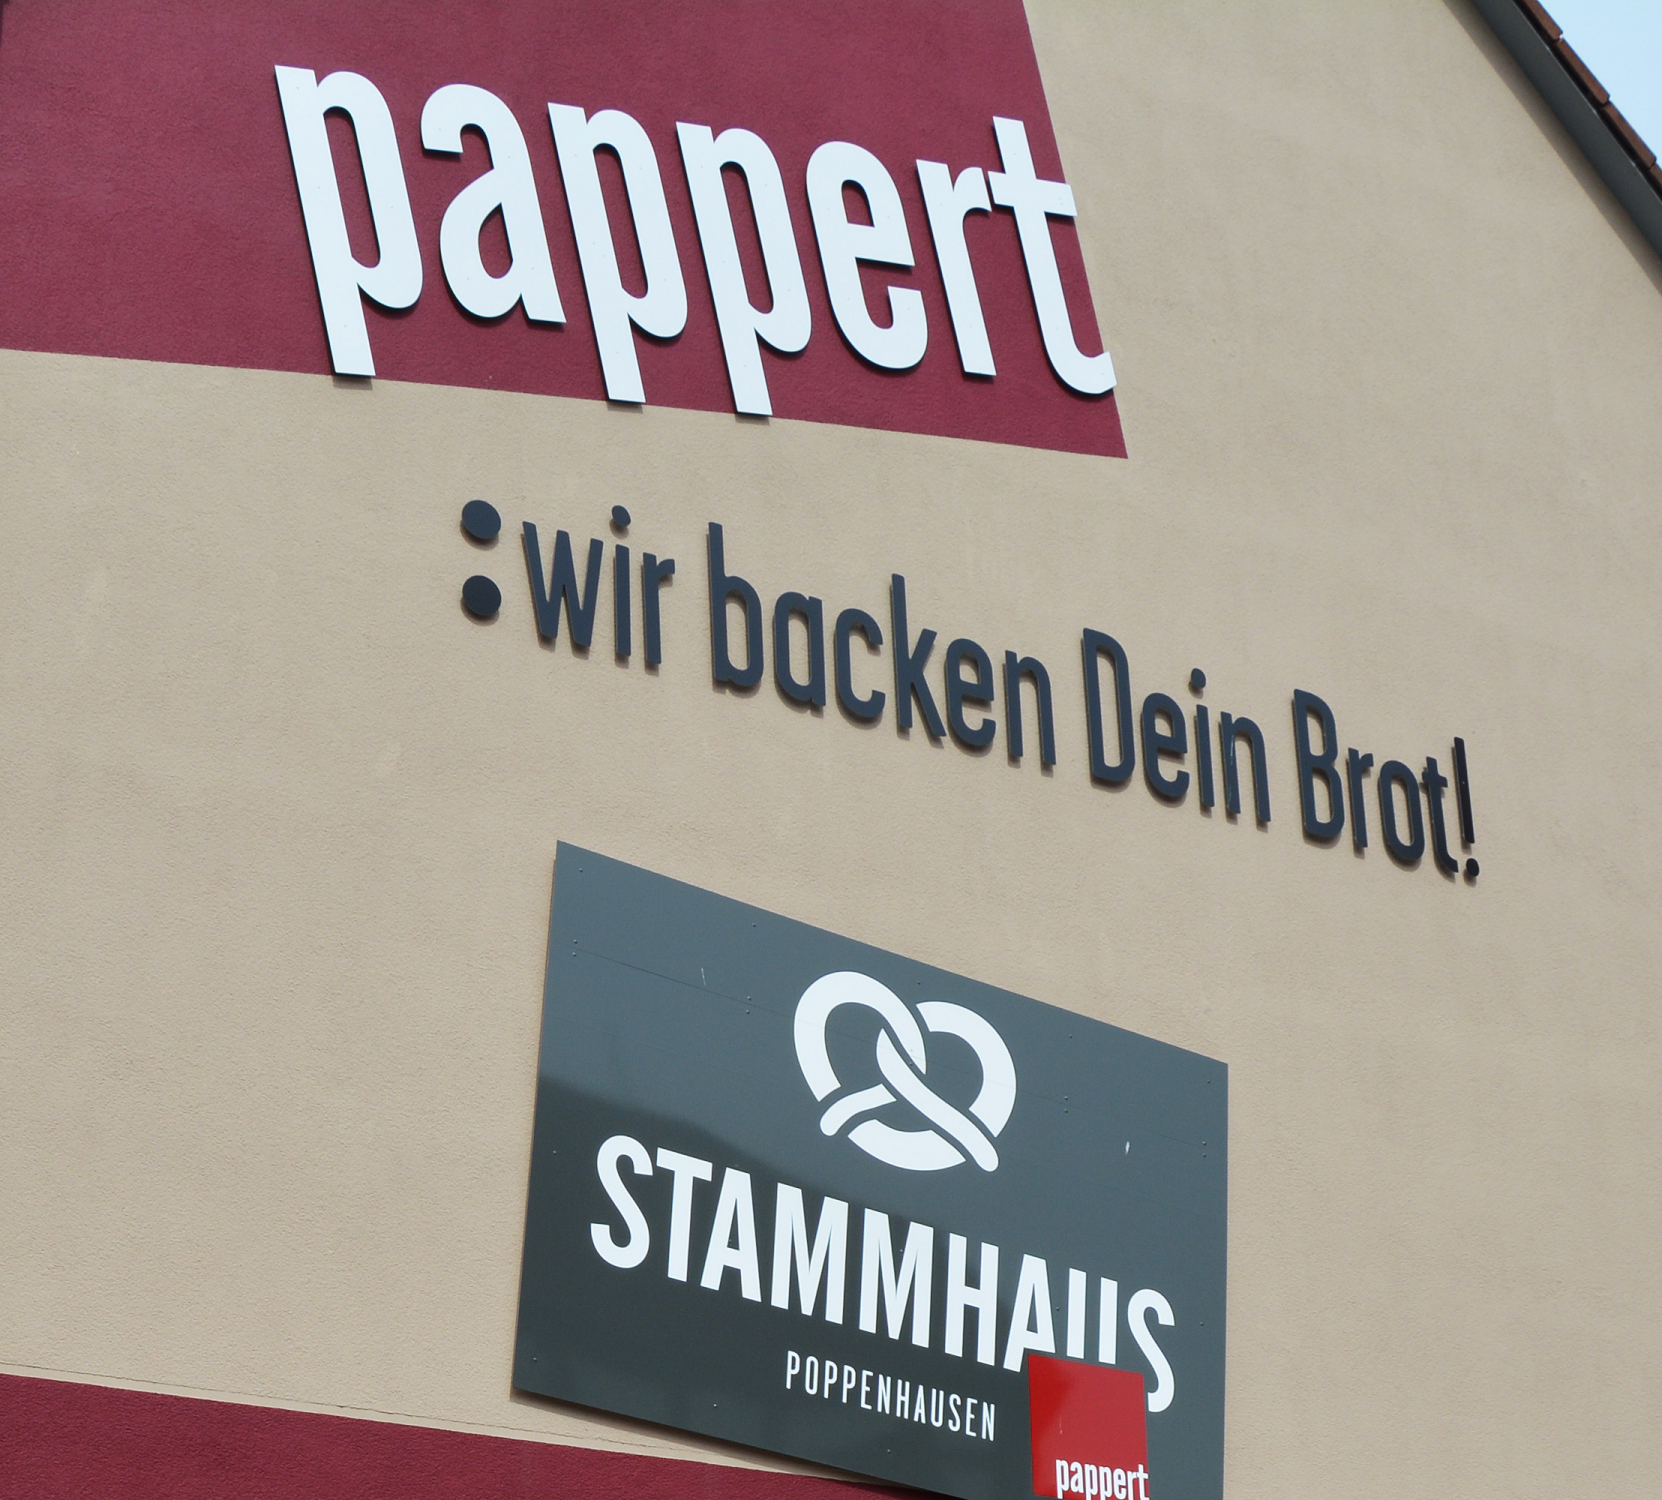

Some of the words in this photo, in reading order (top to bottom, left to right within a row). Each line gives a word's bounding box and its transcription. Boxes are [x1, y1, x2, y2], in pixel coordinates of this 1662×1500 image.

[275, 65, 1118, 416] pappert
[708, 521, 1057, 766] backen
[1082, 627, 1272, 823] Dein
[1293, 688, 1480, 877] Brot!
[590, 1135, 1175, 1413] STAMMHAUS
[785, 1350, 996, 1442] POPPENHAUSEN
